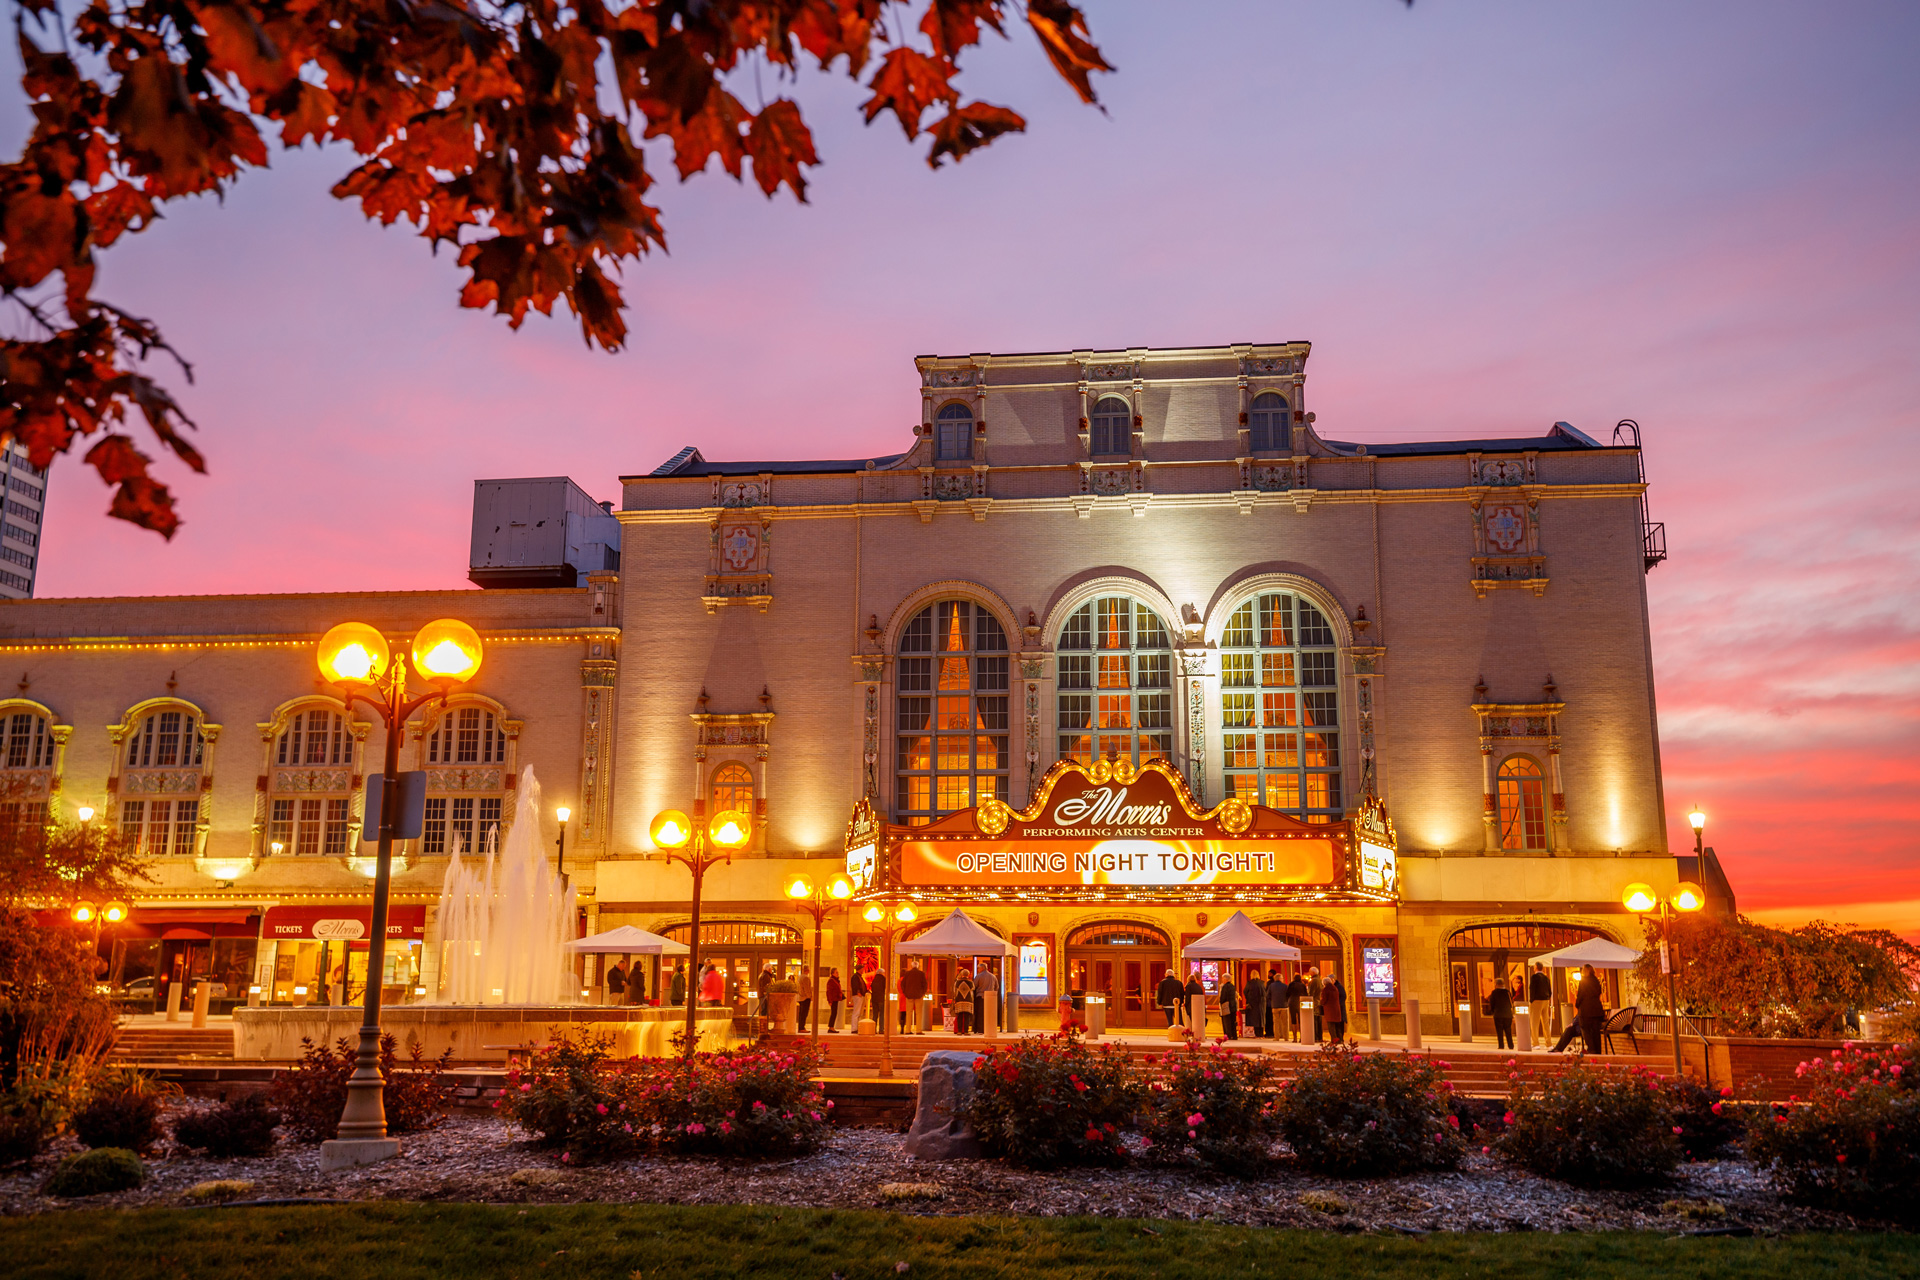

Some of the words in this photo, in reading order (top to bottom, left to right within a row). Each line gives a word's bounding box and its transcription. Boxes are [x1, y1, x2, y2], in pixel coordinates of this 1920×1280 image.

[1081, 790, 1099, 800] The
[1053, 787, 1172, 826] Morris
[1022, 828, 1111, 837] PERFORMING
[1114, 828, 1147, 837] ARTS
[1149, 827, 1205, 837] CENTER
[957, 852, 1066, 874] OPENING
[1074, 852, 1146, 873] NIGHT
[1158, 852, 1275, 873] TONIGHT!
[274, 925, 303, 934] TICKETS
[318, 921, 360, 934] Morris
[387, 925, 403, 934] KETS
